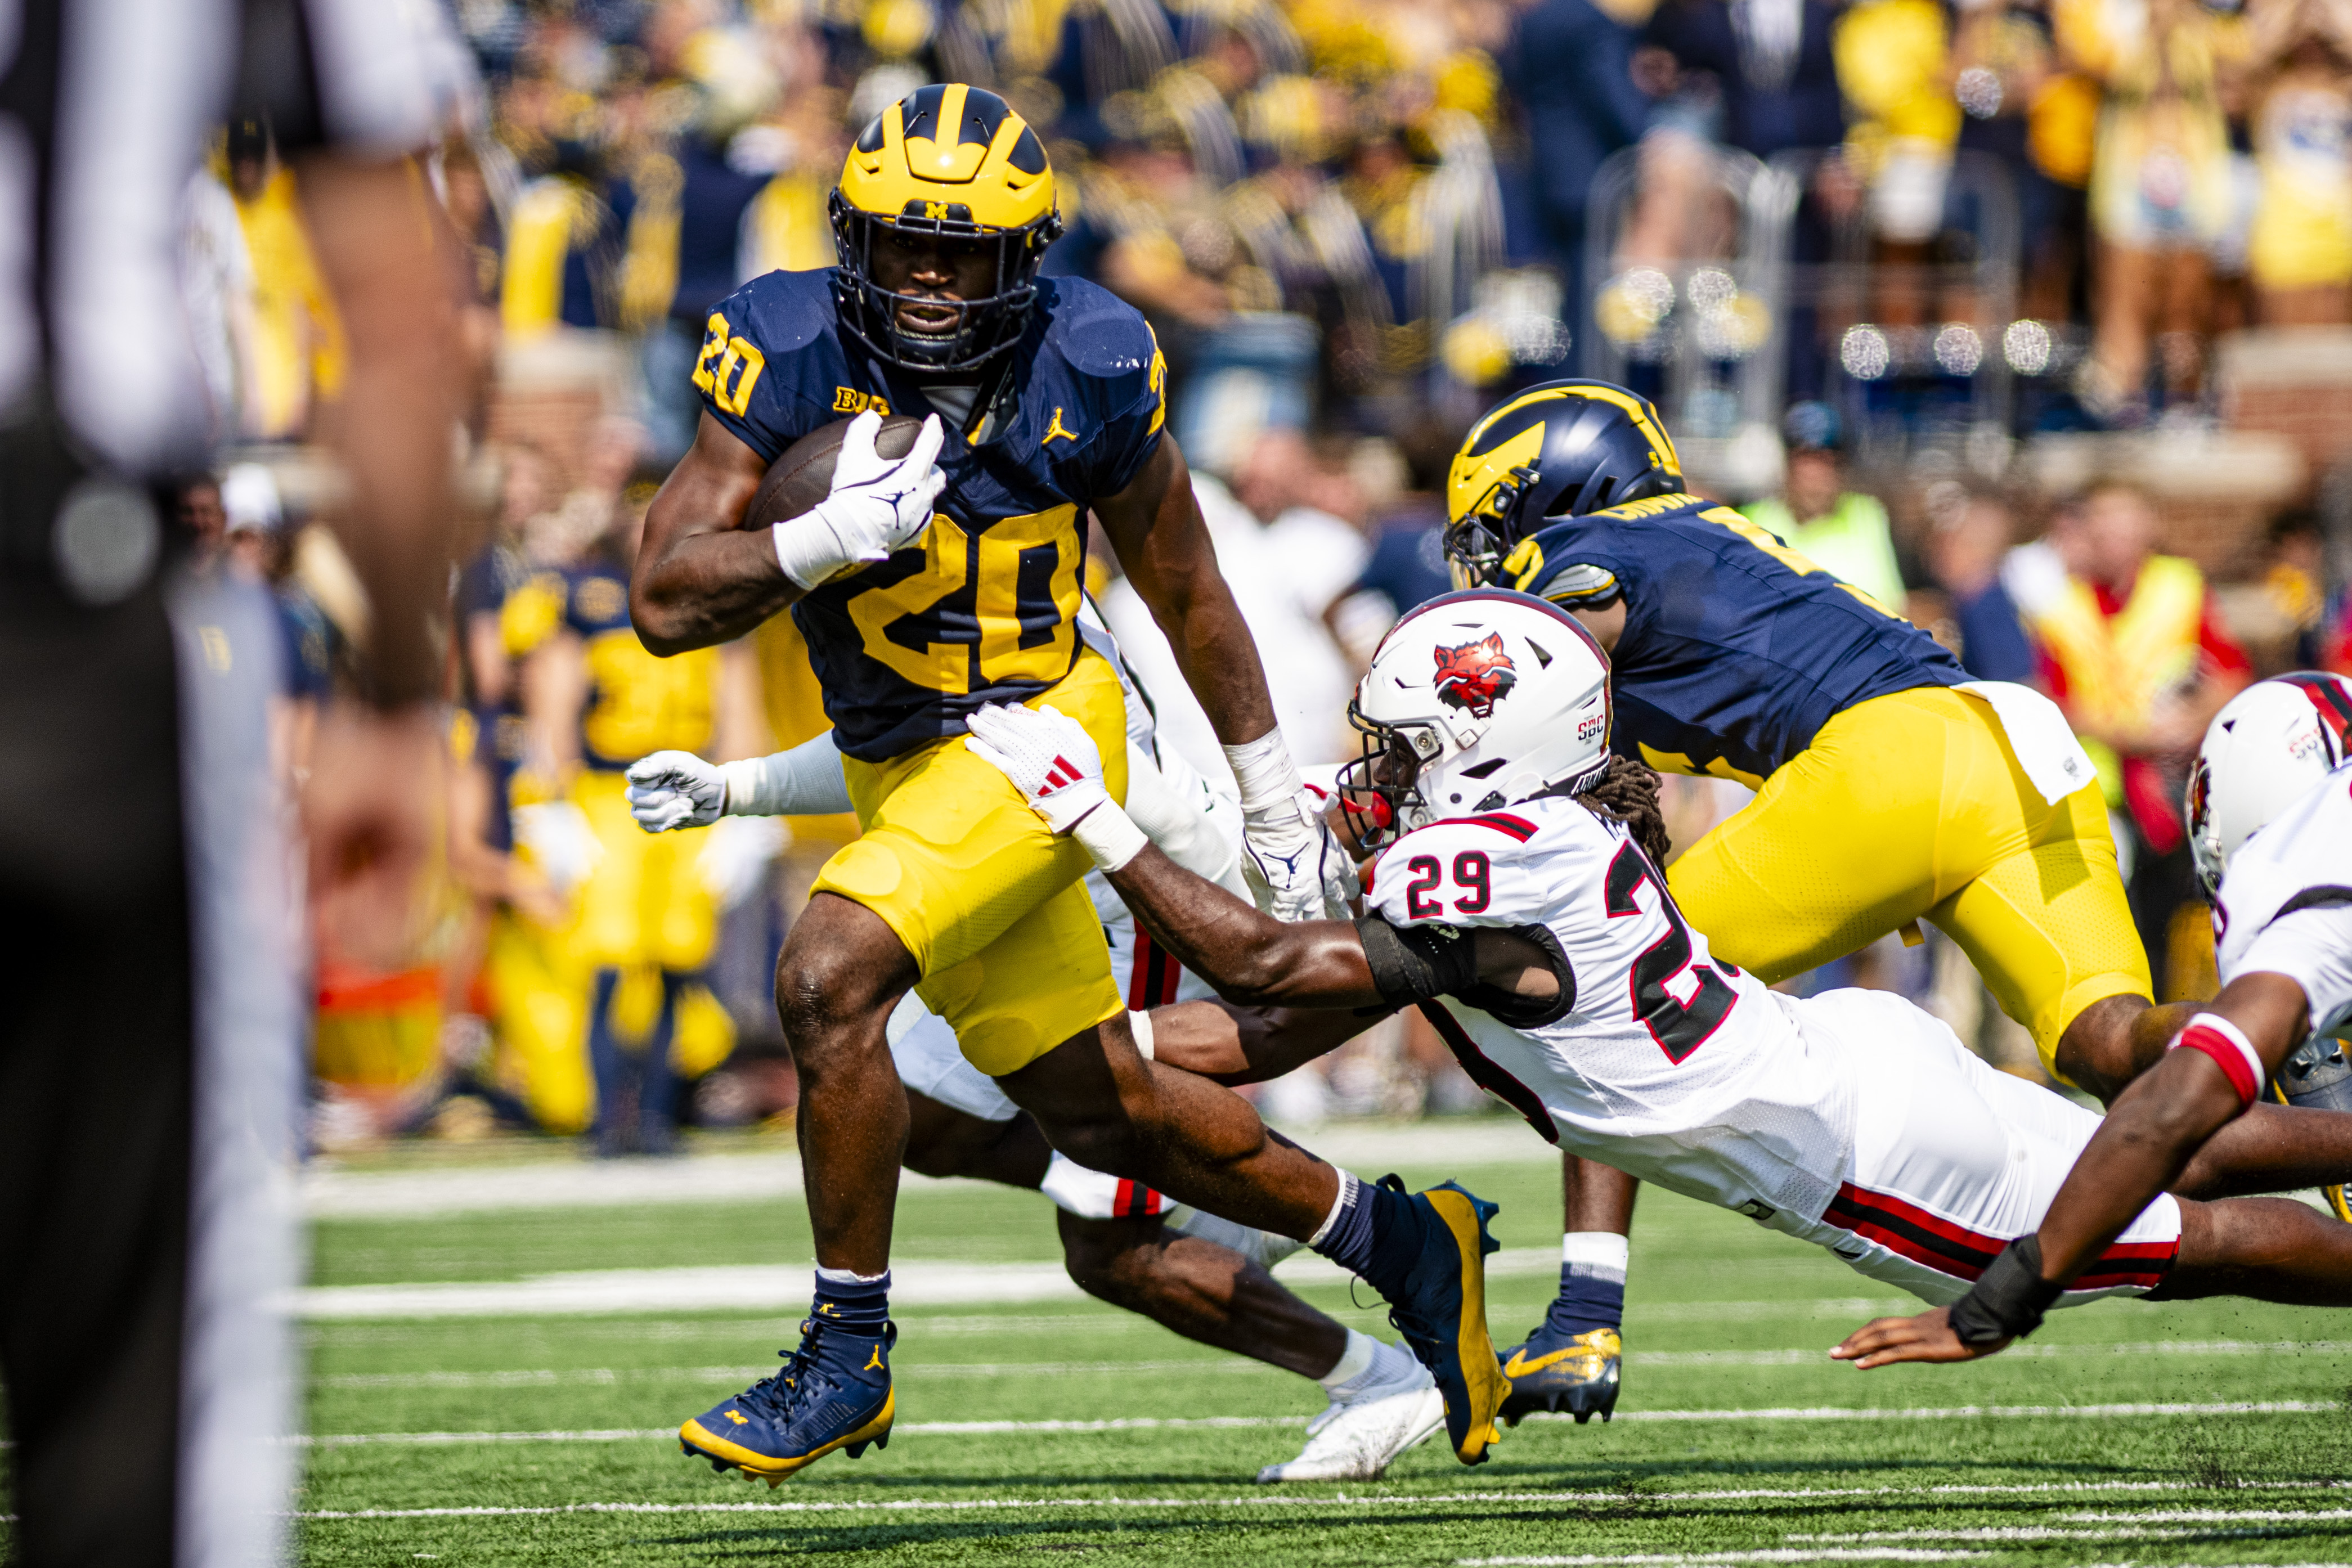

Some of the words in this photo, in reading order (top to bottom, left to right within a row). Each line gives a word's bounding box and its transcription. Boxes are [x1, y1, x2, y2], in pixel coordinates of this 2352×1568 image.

[925, 202, 949, 220] M
[692, 312, 765, 418] 20
[1144, 319, 1168, 437] 2
[847, 502, 1082, 695] 20
[1578, 713, 1604, 741] SBC
[1408, 850, 1491, 920] 29
[1605, 839, 1740, 1066] 2
